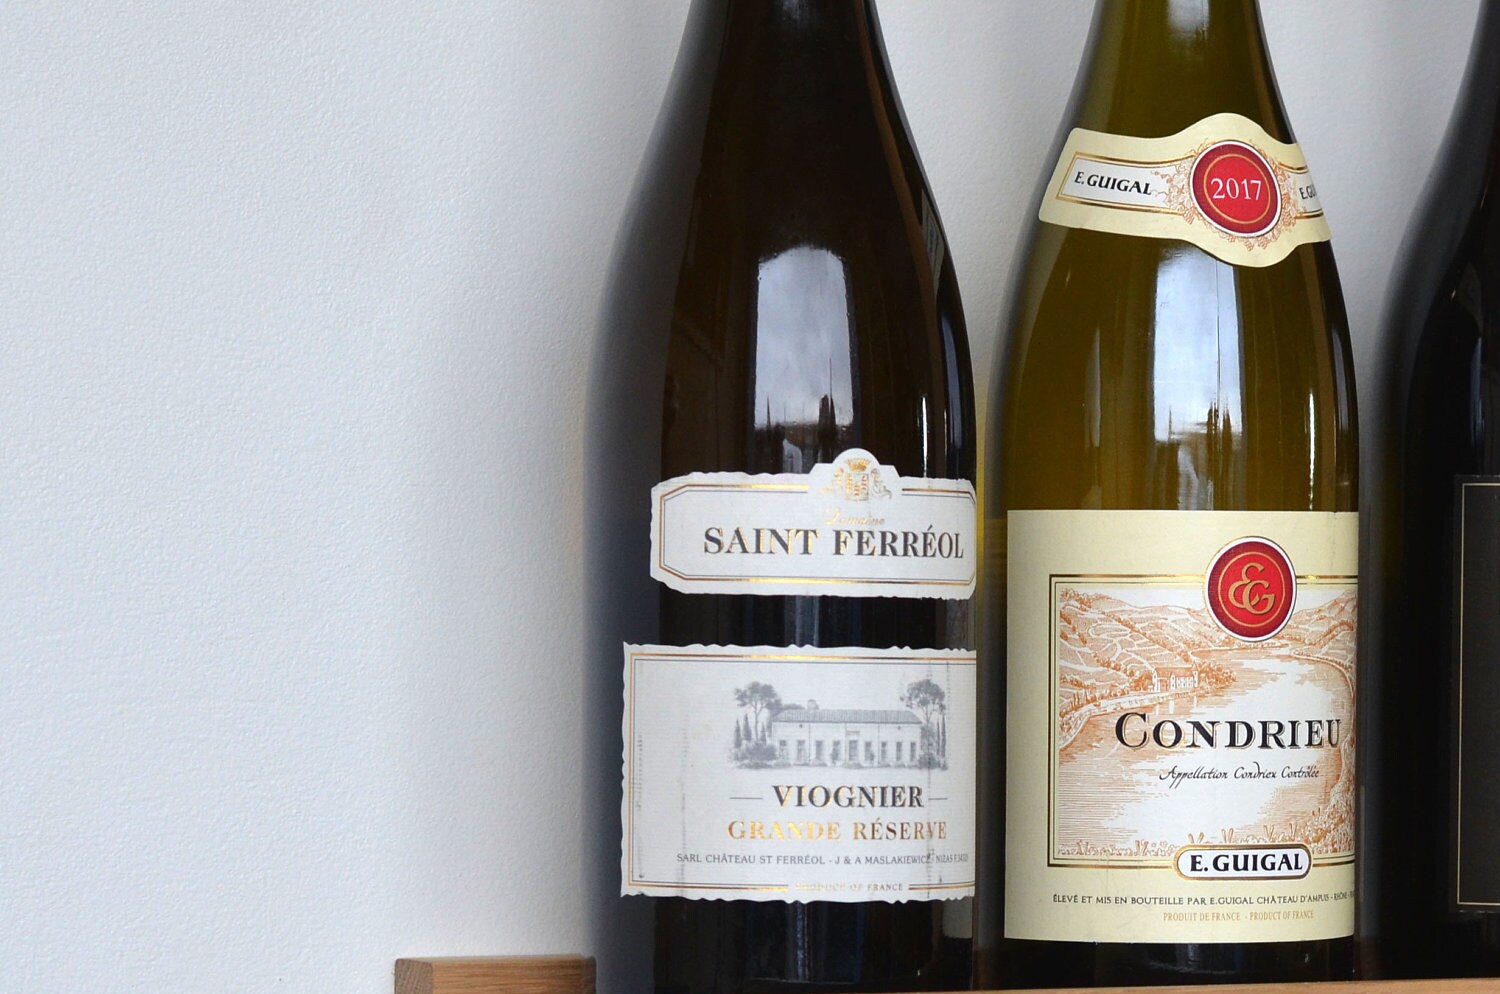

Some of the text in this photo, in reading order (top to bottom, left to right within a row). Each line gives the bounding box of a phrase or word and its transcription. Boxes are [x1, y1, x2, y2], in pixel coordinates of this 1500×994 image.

[1210, 177, 1262, 201] 2017
[704, 524, 964, 560] SAINT FERRÉOL
[1159, 765, 1228, 789] Appellation
[772, 785, 924, 808] VIOGNIER
[727, 817, 947, 841] GRANDE RÉSERVE
[677, 853, 702, 863] SARL
[705, 853, 756, 864] CHÂTEAU
[760, 855, 773, 864] ST
[777, 854, 826, 865] FERRÉOL
[835, 855, 840, 864] J
[843, 855, 851, 865] &
[855, 855, 862, 864] A
[867, 882, 902, 891] FRANCE
[1053, 894, 1078, 903] ÉLEVÉ
[1081, 896, 1092, 904] ET
[1096, 896, 1111, 904] MIS
[1115, 896, 1127, 904] EN
[1131, 896, 1183, 905] BOUTEILLE
[1187, 897, 1206, 905] PAR
[1210, 896, 1254, 905] E.GUIGAL
[1257, 895, 1298, 904] CHÂTEAU
[1163, 912, 1197, 921] PRODUIT
[1200, 912, 1210, 921] DE
[1211, 912, 1240, 921] FRANCE
[1250, 911, 1281, 921] PRODUCT
[1283, 911, 1290, 920] OF
